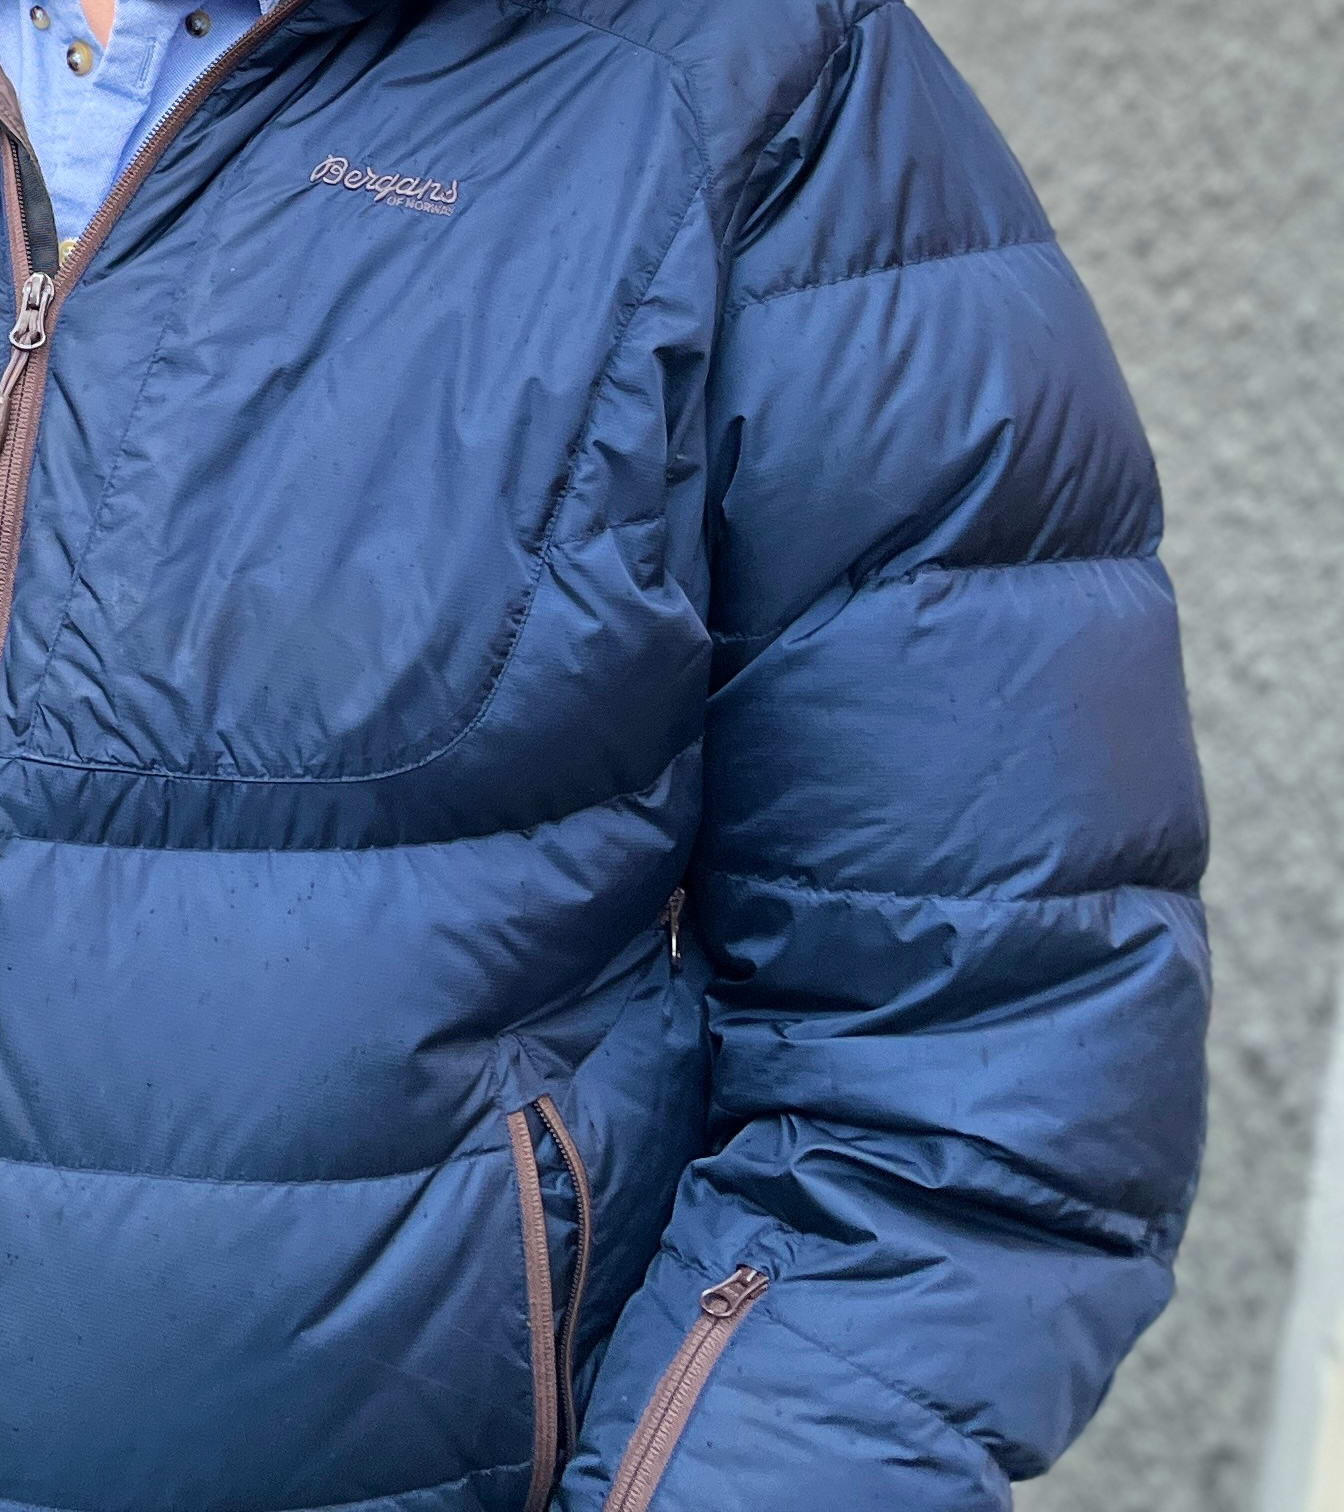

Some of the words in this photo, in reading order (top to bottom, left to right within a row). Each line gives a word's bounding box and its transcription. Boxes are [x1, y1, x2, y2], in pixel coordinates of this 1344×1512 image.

[310, 154, 458, 203] Bergans
[386, 196, 405, 207] OF
[405, 198, 455, 217] NORWAY
